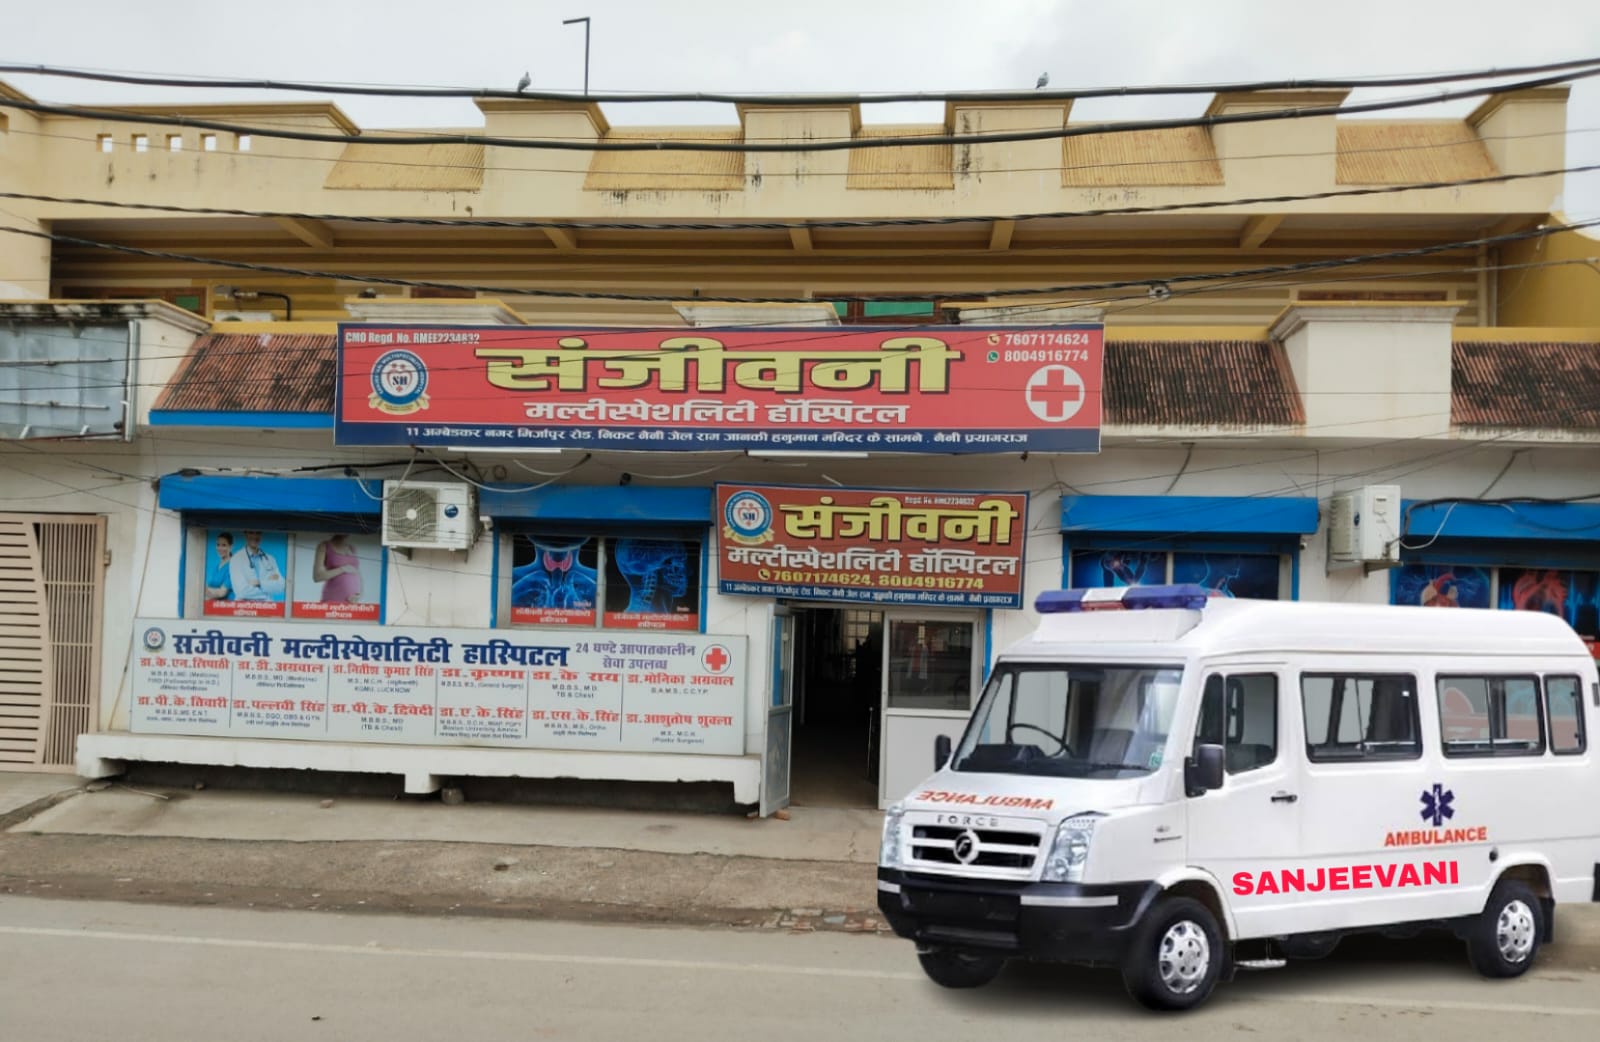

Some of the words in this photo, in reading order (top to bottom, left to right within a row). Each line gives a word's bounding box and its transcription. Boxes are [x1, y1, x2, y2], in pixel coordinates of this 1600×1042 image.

[345, 332, 366, 343] CMO
[1004, 333, 1089, 345] 7607174624
[1004, 350, 1089, 362] 8004916774
[475, 337, 961, 393] संजीवनी
[524, 399, 756, 422] मल्टीस्पेशलिटी
[765, 399, 909, 423] हॉस्पिटल
[779, 497, 1018, 544] संजीवनी
[725, 544, 902, 572] मल्टीस्पेशलिटी
[907, 549, 1019, 576] हॉस्पिटल
[878, 577, 984, 590] 8004916774
[172, 629, 273, 658] संजीवनी
[281, 634, 452, 664] मल्टीस्पेशलिटी
[575, 643, 588, 653] 24
[593, 641, 616, 654] घण्टे
[620, 643, 696, 656] आपातकालीन
[602, 656, 624, 669] सेवा
[628, 660, 668, 670] उपलब्ध
[937, 814, 999, 827] FORCE
[1384, 827, 1487, 847] AMBULANCE
[1232, 861, 1459, 896] SANJEEVANI
